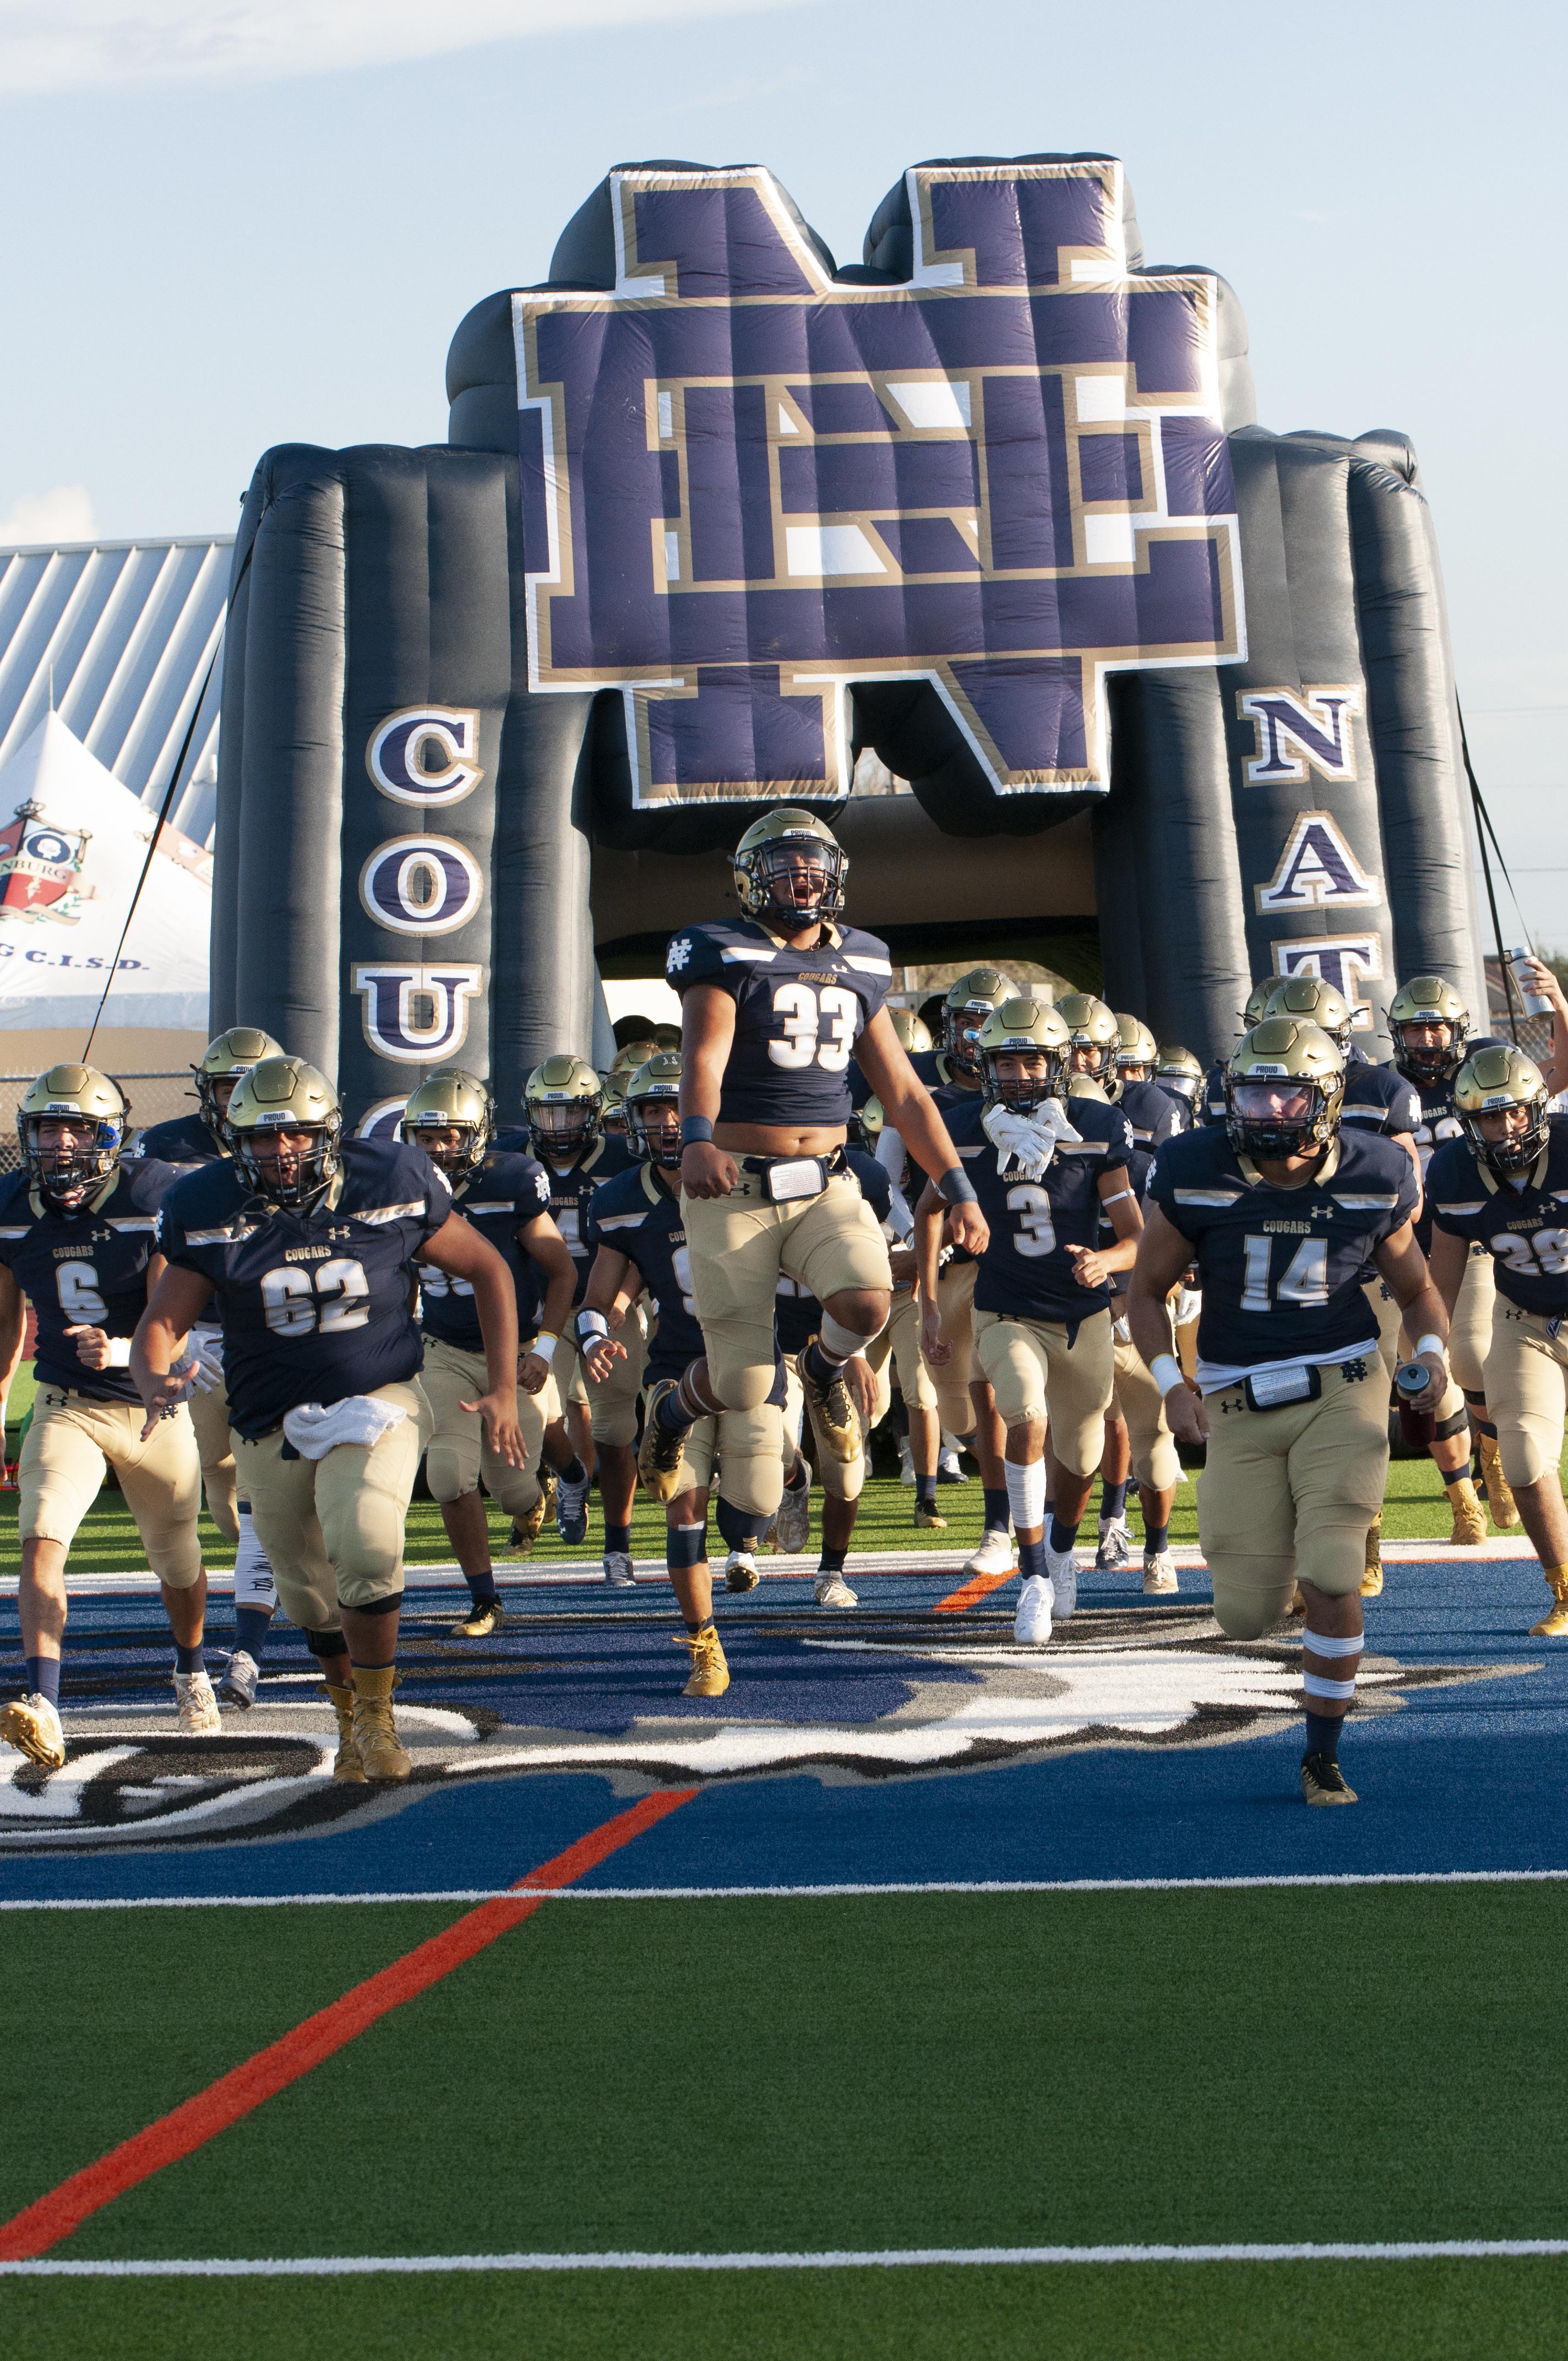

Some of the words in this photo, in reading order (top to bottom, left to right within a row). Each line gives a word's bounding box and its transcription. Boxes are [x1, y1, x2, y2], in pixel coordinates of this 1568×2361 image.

[25, 950, 150, 970] C.I.S.D.
[798, 972, 837, 985] COUGARS
[769, 983, 858, 1071] 33
[1256, 1065, 1277, 1074] PROUD
[1488, 1096, 1505, 1105] PROUD
[264, 1113, 285, 1122] PROUD
[1422, 1106, 1447, 1119] UGARS
[550, 1196, 578, 1206] OUGARS
[1006, 1184, 1056, 1257] 3
[1263, 1220, 1311, 1234] COUGARS
[1506, 1217, 1544, 1231] COUGARS
[52, 1245, 94, 1259] COUGARS
[285, 1245, 331, 1262] COUGARS
[1240, 1234, 1329, 1312] 14
[56, 1261, 109, 1324] 6
[260, 1259, 370, 1337] 62
